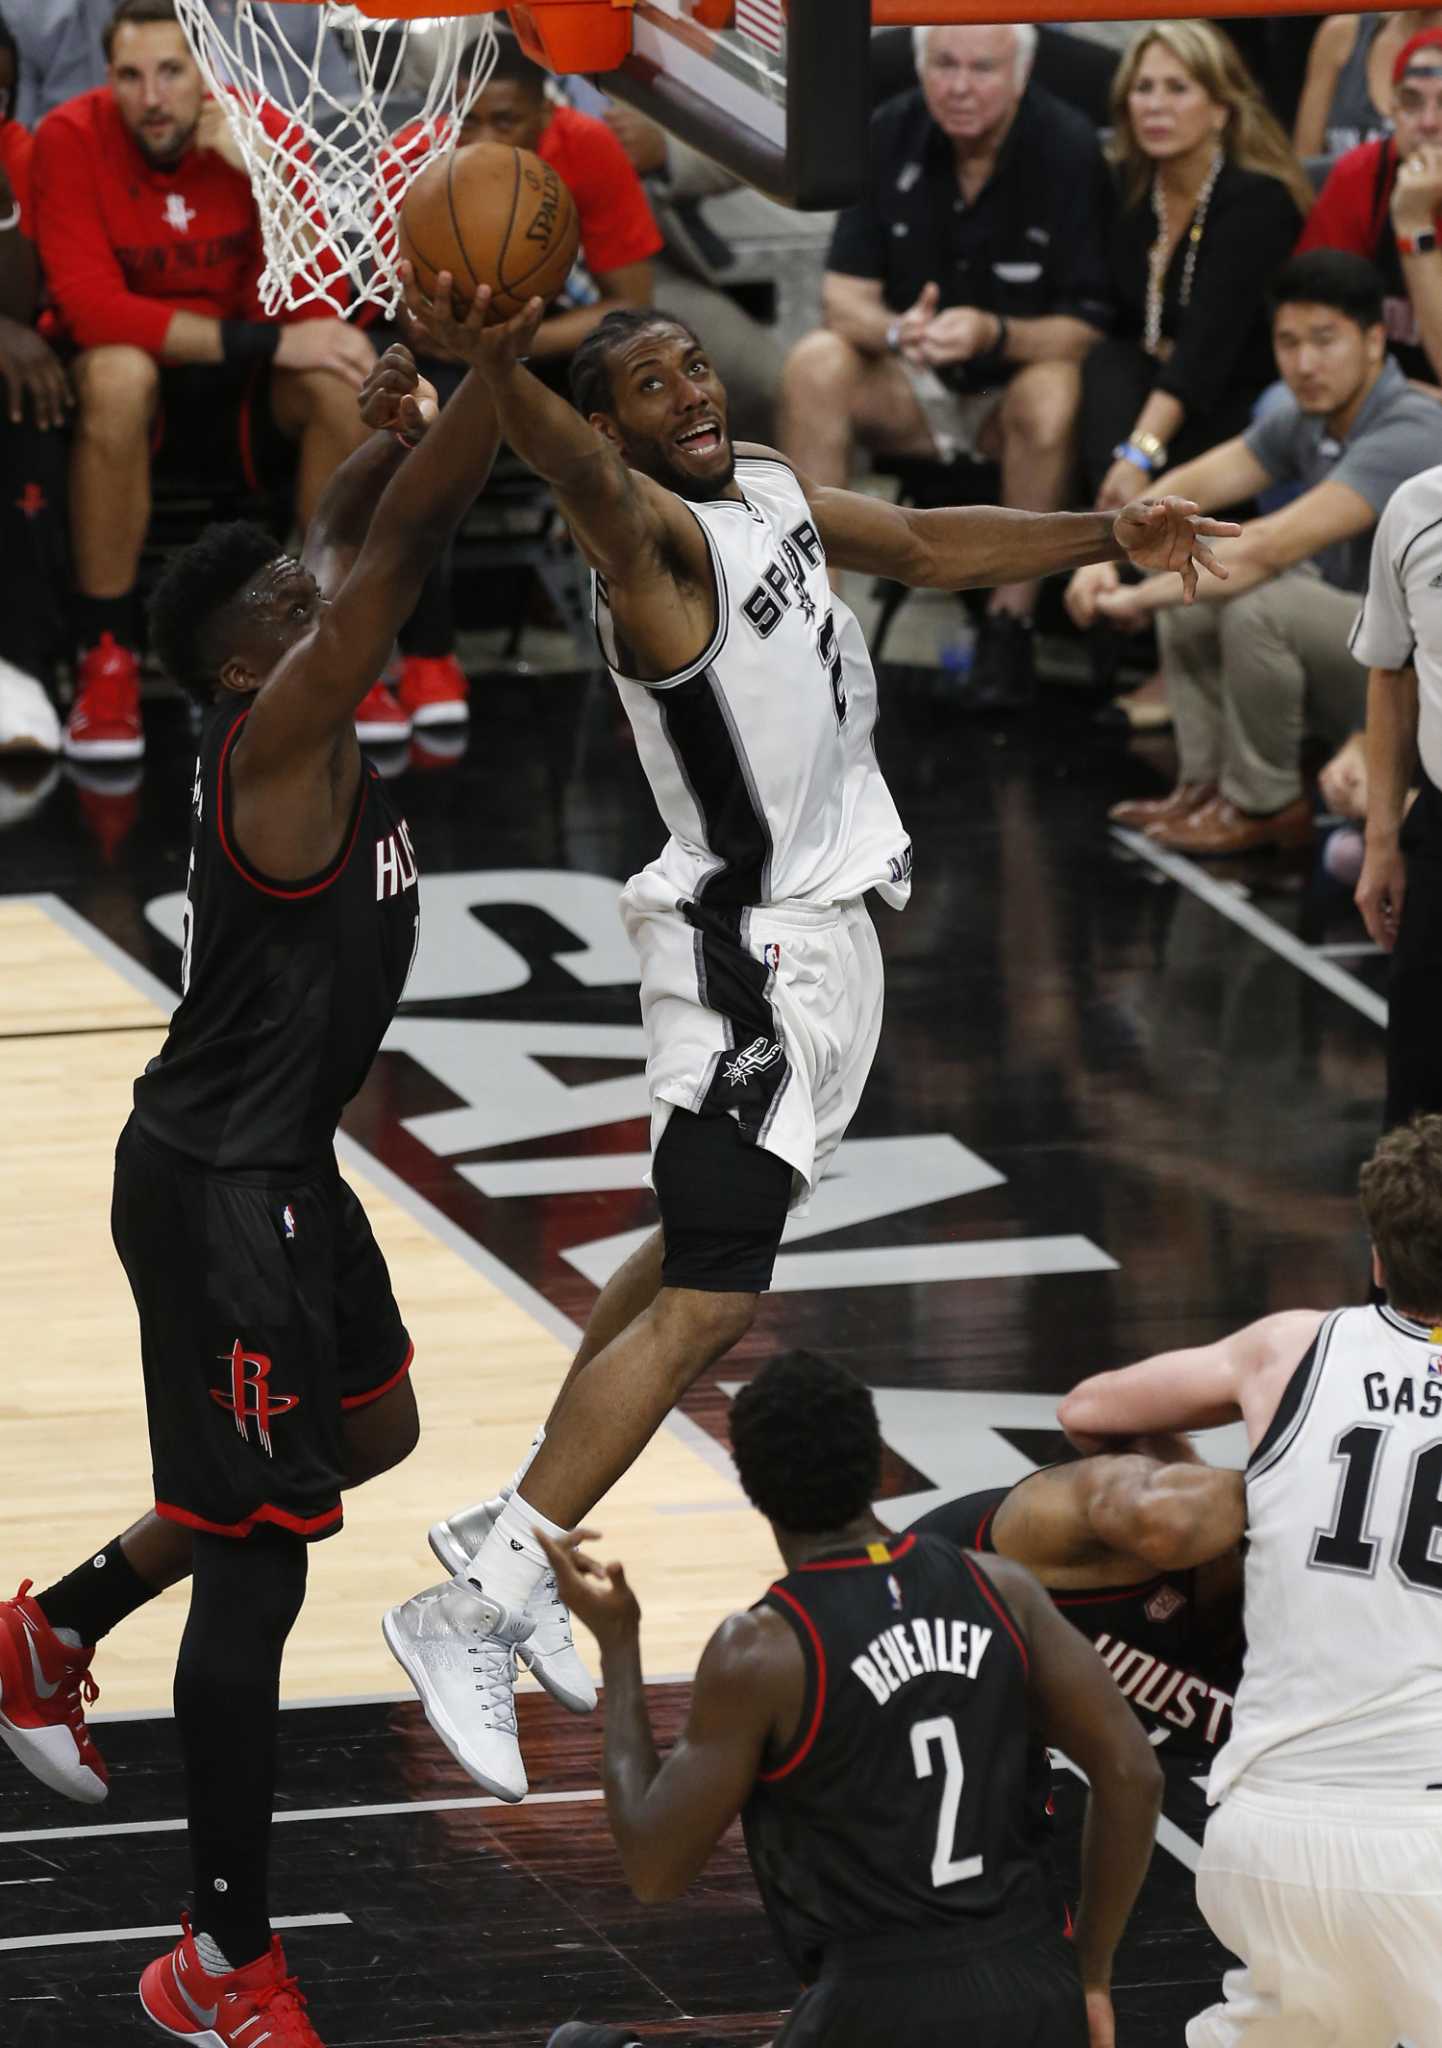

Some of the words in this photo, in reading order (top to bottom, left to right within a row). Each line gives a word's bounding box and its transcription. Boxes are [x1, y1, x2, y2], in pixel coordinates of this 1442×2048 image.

[739, 519, 825, 640] SPUR
[1363, 1371, 1442, 1419] GAS
[850, 1616, 993, 1706] BEVERLEY
[1094, 1632, 1235, 1745] HOUST
[910, 1714, 984, 1888] 2
